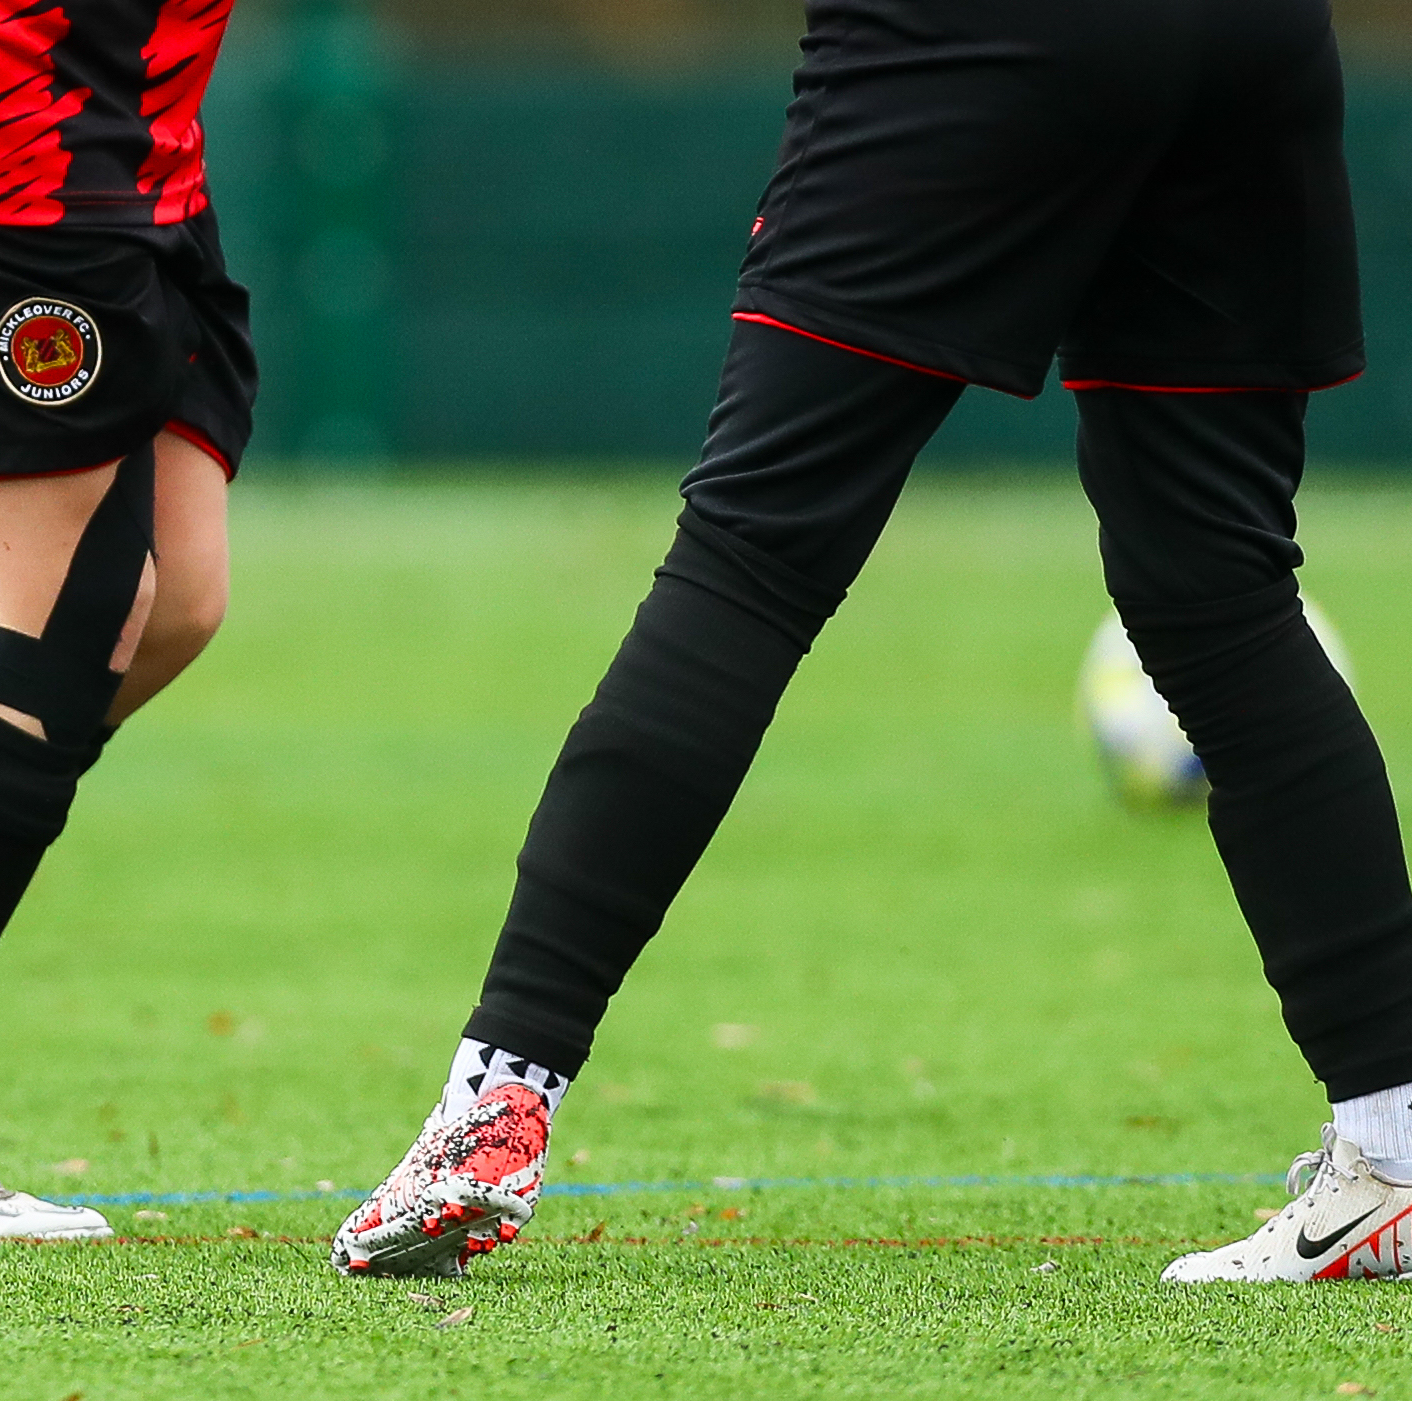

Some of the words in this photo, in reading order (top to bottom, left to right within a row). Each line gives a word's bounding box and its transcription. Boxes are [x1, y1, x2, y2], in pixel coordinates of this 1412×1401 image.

[0, 305, 74, 352] MICKLEOVER
[73, 315, 90, 333] FC
[20, 369, 89, 399] JUNIORS
